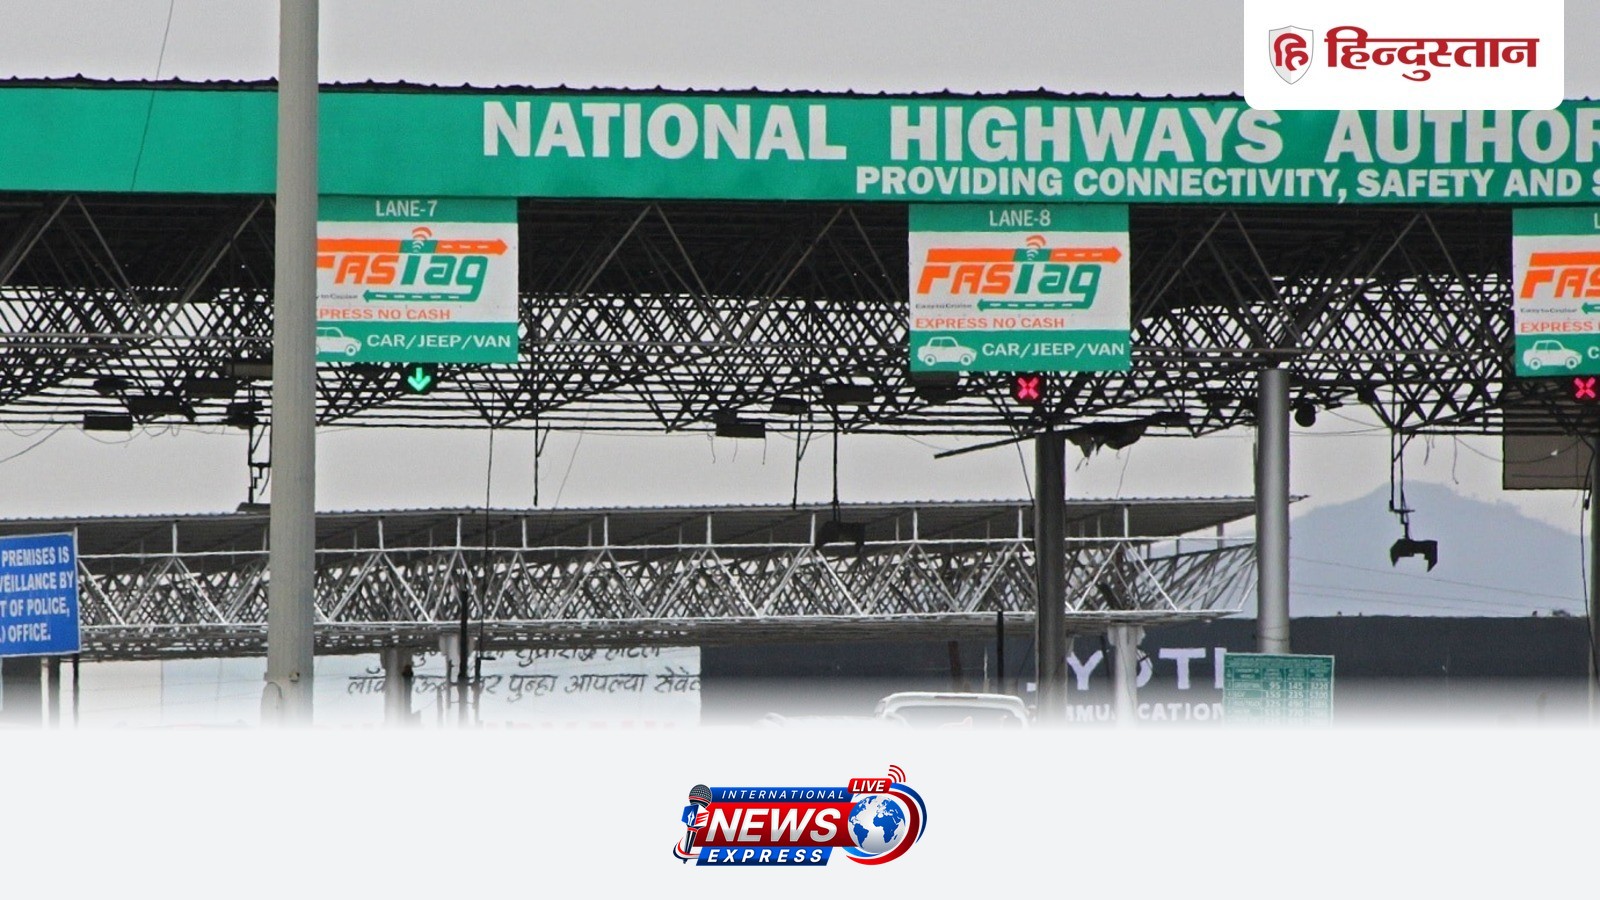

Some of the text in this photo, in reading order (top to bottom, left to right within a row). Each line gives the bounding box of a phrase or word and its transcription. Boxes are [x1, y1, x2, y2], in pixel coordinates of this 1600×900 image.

[483, 101, 847, 160] NATIONAL
[890, 105, 1283, 164] HIGHWAYS
[856, 166, 1063, 197] PROVIDING
[1073, 167, 1347, 204] CONNECTIVITY,
[1357, 168, 1495, 198] SAFETY
[1504, 168, 1582, 197] AND
[375, 200, 438, 217] LANE-7
[989, 209, 1051, 227] LANE-8
[317, 308, 451, 320] PRESS NO CASH
[915, 317, 1065, 329] EXPRESS NO CASH
[1520, 320, 1593, 333] EXPRESS
[366, 334, 511, 350] CAR/JEEP/VAN
[981, 342, 1125, 358] CAR/JEEP/VAN
[2, 546, 70, 568] PREMISES IS
[60, 570, 74, 589] BY
[10, 598, 24, 617] OF
[27, 596, 70, 618] POLICE,
[8, 622, 51, 643] OFFICE.
[565, 673, 648, 694] आपल्या
